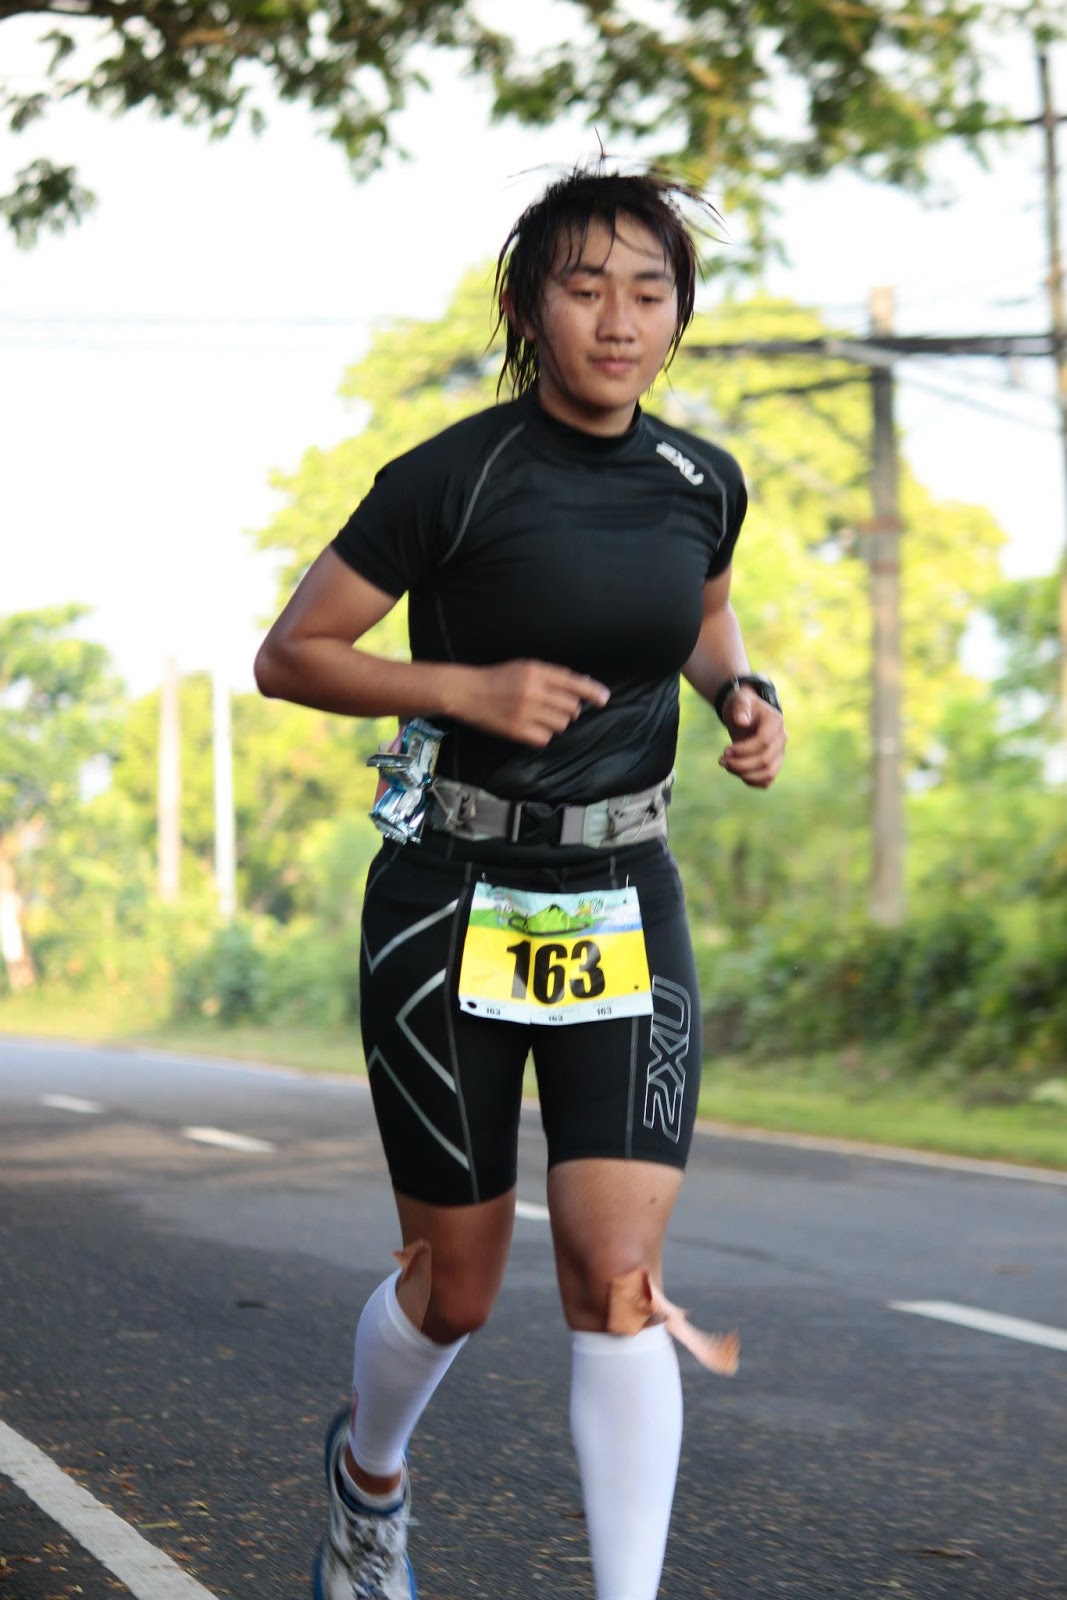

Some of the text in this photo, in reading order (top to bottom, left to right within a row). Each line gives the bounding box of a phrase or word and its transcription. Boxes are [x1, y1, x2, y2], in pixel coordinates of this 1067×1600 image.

[506, 939, 606, 1005] 163
[486, 1007, 501, 1016] 163
[597, 1007, 612, 1016] 163
[548, 1014, 564, 1022] 163
[643, 975, 691, 1144] 2XU
